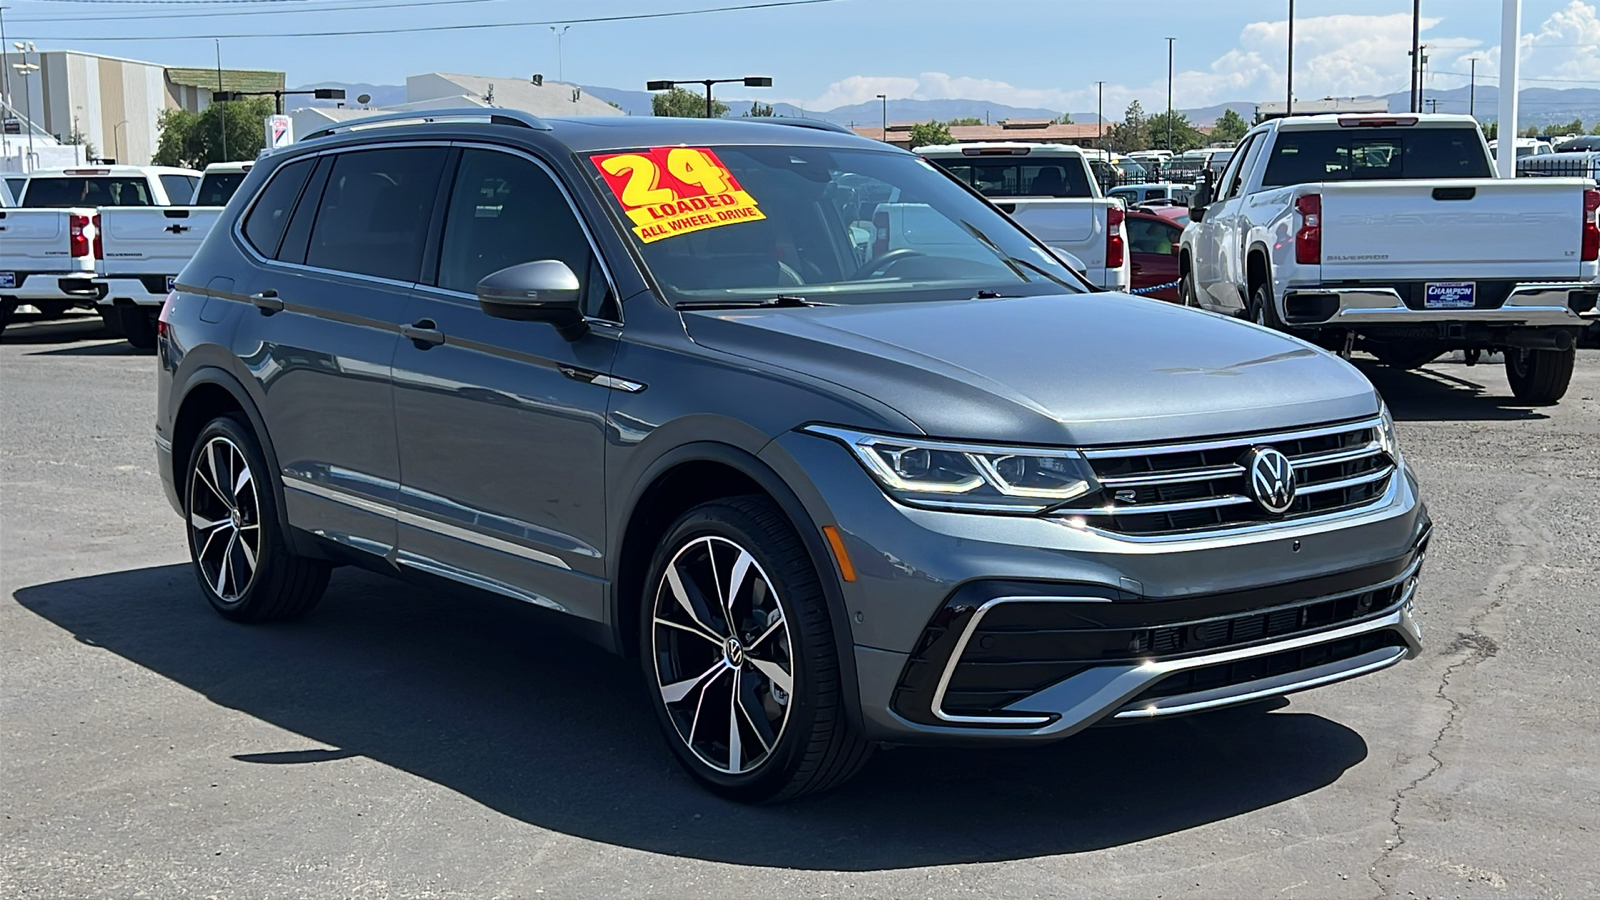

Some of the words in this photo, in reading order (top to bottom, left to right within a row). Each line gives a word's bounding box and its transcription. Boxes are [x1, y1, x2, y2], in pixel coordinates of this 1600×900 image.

[601, 148, 735, 207] 24
[647, 193, 738, 220] LOADED
[641, 224, 668, 239] ALL
[667, 213, 716, 231] WHEEL
[716, 206, 757, 221] DRIVE
[1428, 286, 1472, 295] CHAMPION
